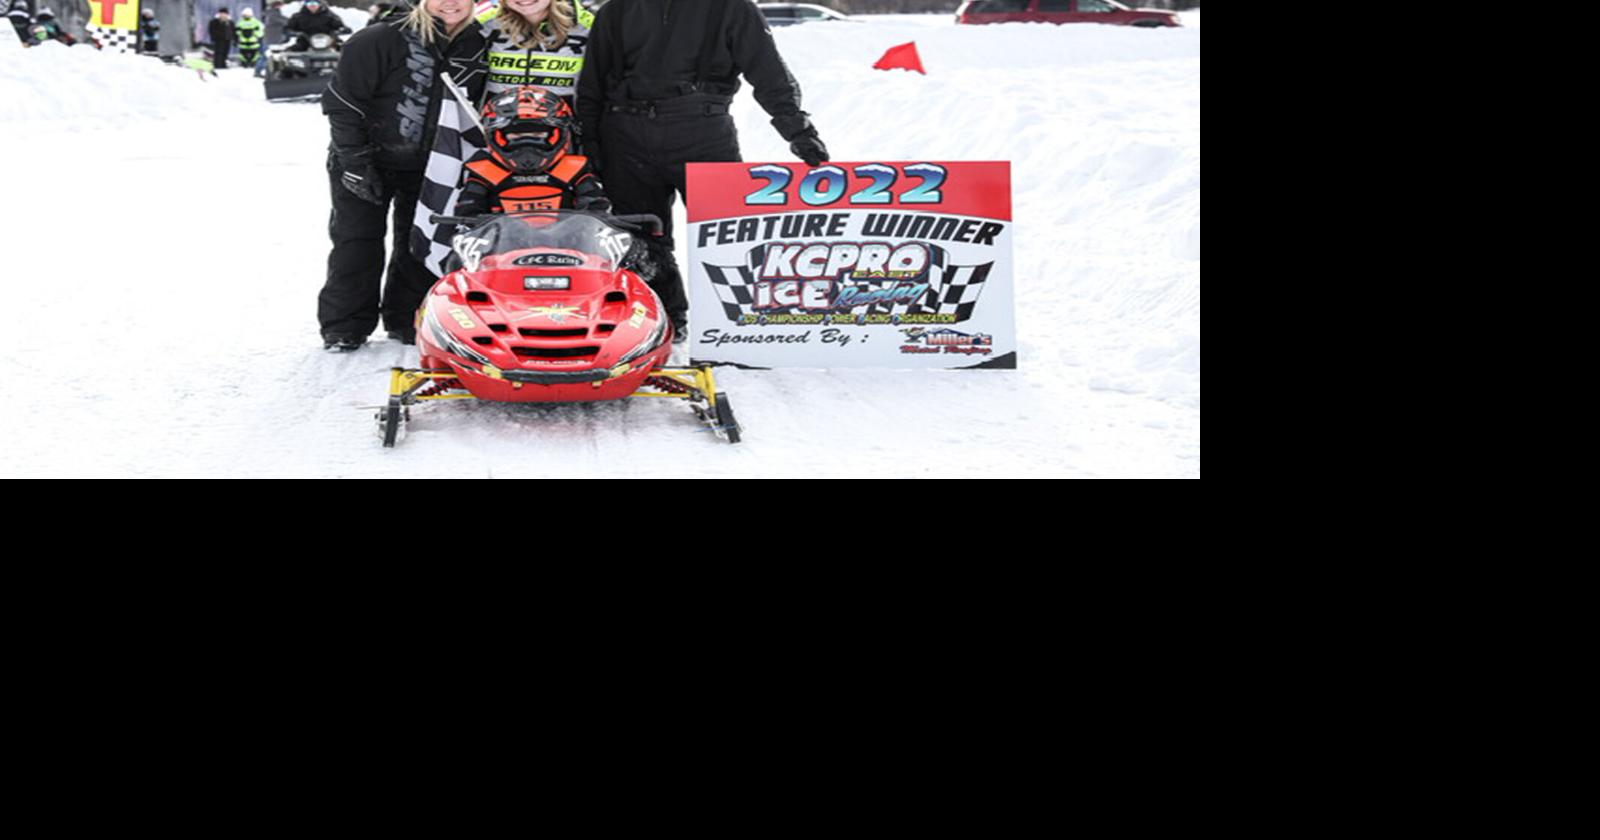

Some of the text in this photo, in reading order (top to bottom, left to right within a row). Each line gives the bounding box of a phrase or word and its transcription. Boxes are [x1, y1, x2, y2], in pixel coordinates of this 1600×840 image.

[489, 56, 546, 69] RACE
[745, 162, 947, 206] 2022
[698, 213, 1004, 248] FEATURE WINNER
[760, 242, 929, 278] KCPRO
[833, 281, 929, 307] Racing
[699, 329, 811, 347] Sponsored
[820, 328, 851, 347] By
